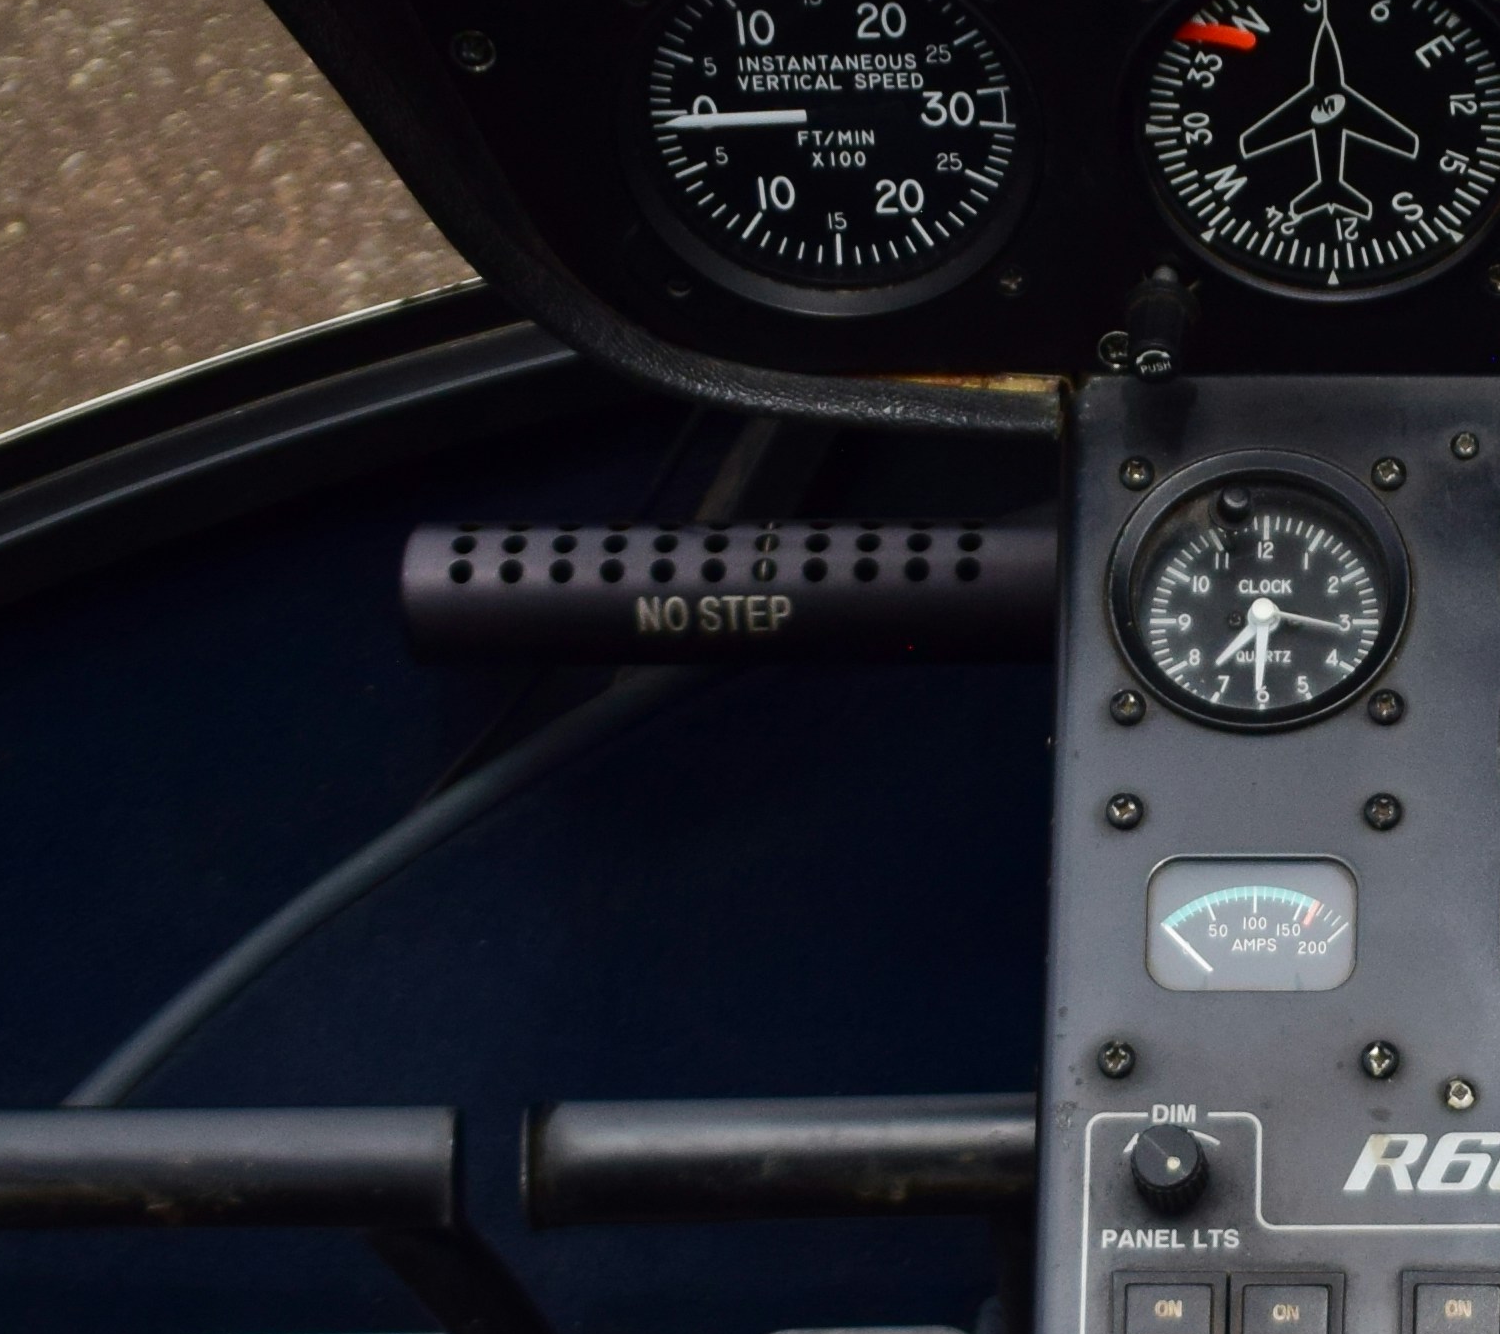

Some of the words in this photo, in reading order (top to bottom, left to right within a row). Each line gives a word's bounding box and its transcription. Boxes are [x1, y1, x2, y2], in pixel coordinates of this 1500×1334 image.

[737, 9, 775, 46] 10
[856, 1, 907, 39] 20
[1415, 34, 1455, 68] E
[738, 53, 917, 72] INSTANTANEOUS
[738, 74, 842, 91] VERTICAL
[855, 72, 924, 90] SPEED
[921, 90, 975, 127] 30
[797, 129, 875, 146] FT/MIN
[812, 151, 867, 168] X100
[758, 175, 796, 211] 10
[875, 178, 924, 215] 20
[1392, 192, 1424, 222] S
[1139, 359, 1172, 375] PUSH
[1238, 579, 1292, 594] CLOCK
[635, 596, 689, 633] NO
[700, 595, 793, 632] STEP
[1231, 938, 1277, 952] AMPS
[1151, 1103, 1197, 1124] DIM
[1101, 1229, 1185, 1248] PANEL
[1193, 1228, 1240, 1249] LTS
[1154, 1299, 1183, 1319] ON
[1272, 1303, 1300, 1322] ON
[1444, 1299, 1473, 1318] ON
